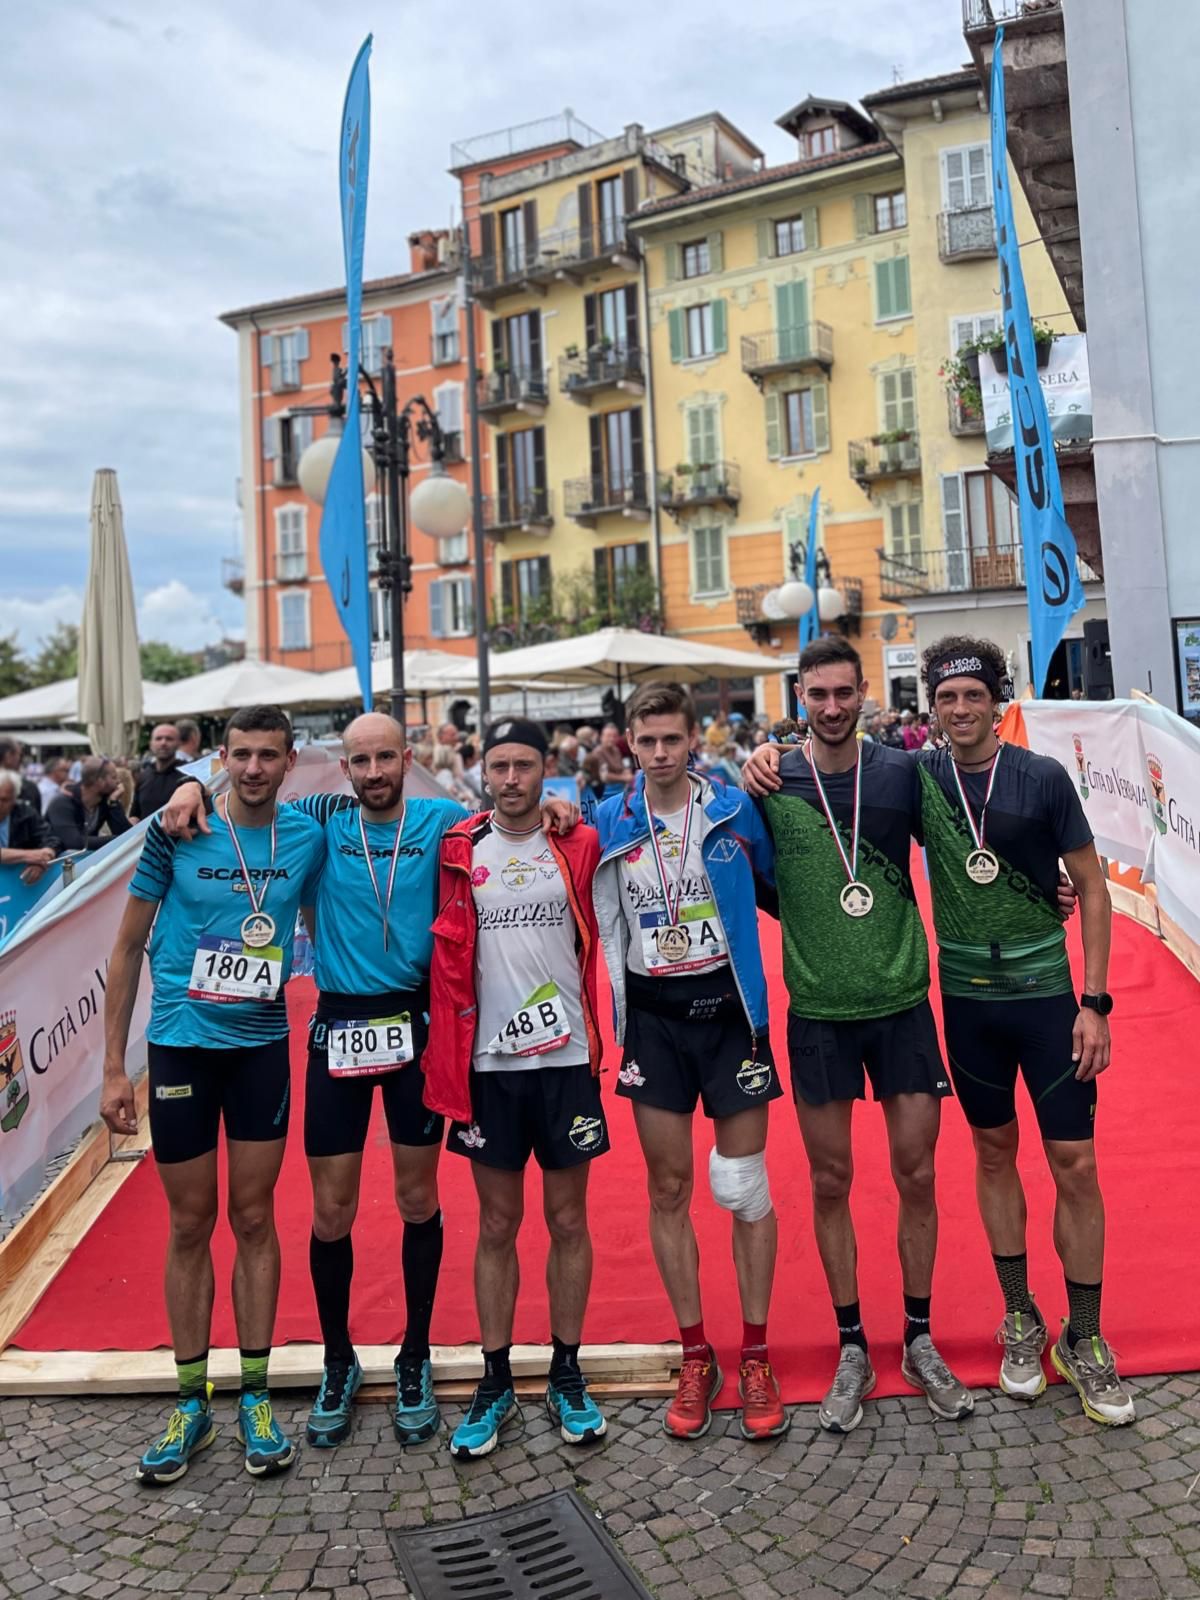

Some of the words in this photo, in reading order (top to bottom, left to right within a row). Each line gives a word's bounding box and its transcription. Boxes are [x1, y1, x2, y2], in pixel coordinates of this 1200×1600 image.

[1038, 371, 1080, 386] SERA
[339, 844, 425, 858] SCARPA
[197, 867, 289, 881] SCARPA
[700, 920, 718, 946] A
[205, 953, 248, 981] 180
[253, 961, 272, 985] A
[537, 1001, 558, 1028] B
[29, 1006, 77, 1075] CITTÀ
[78, 988, 98, 1027] DI
[337, 1029, 378, 1055] 180
[386, 1026, 404, 1051] B
